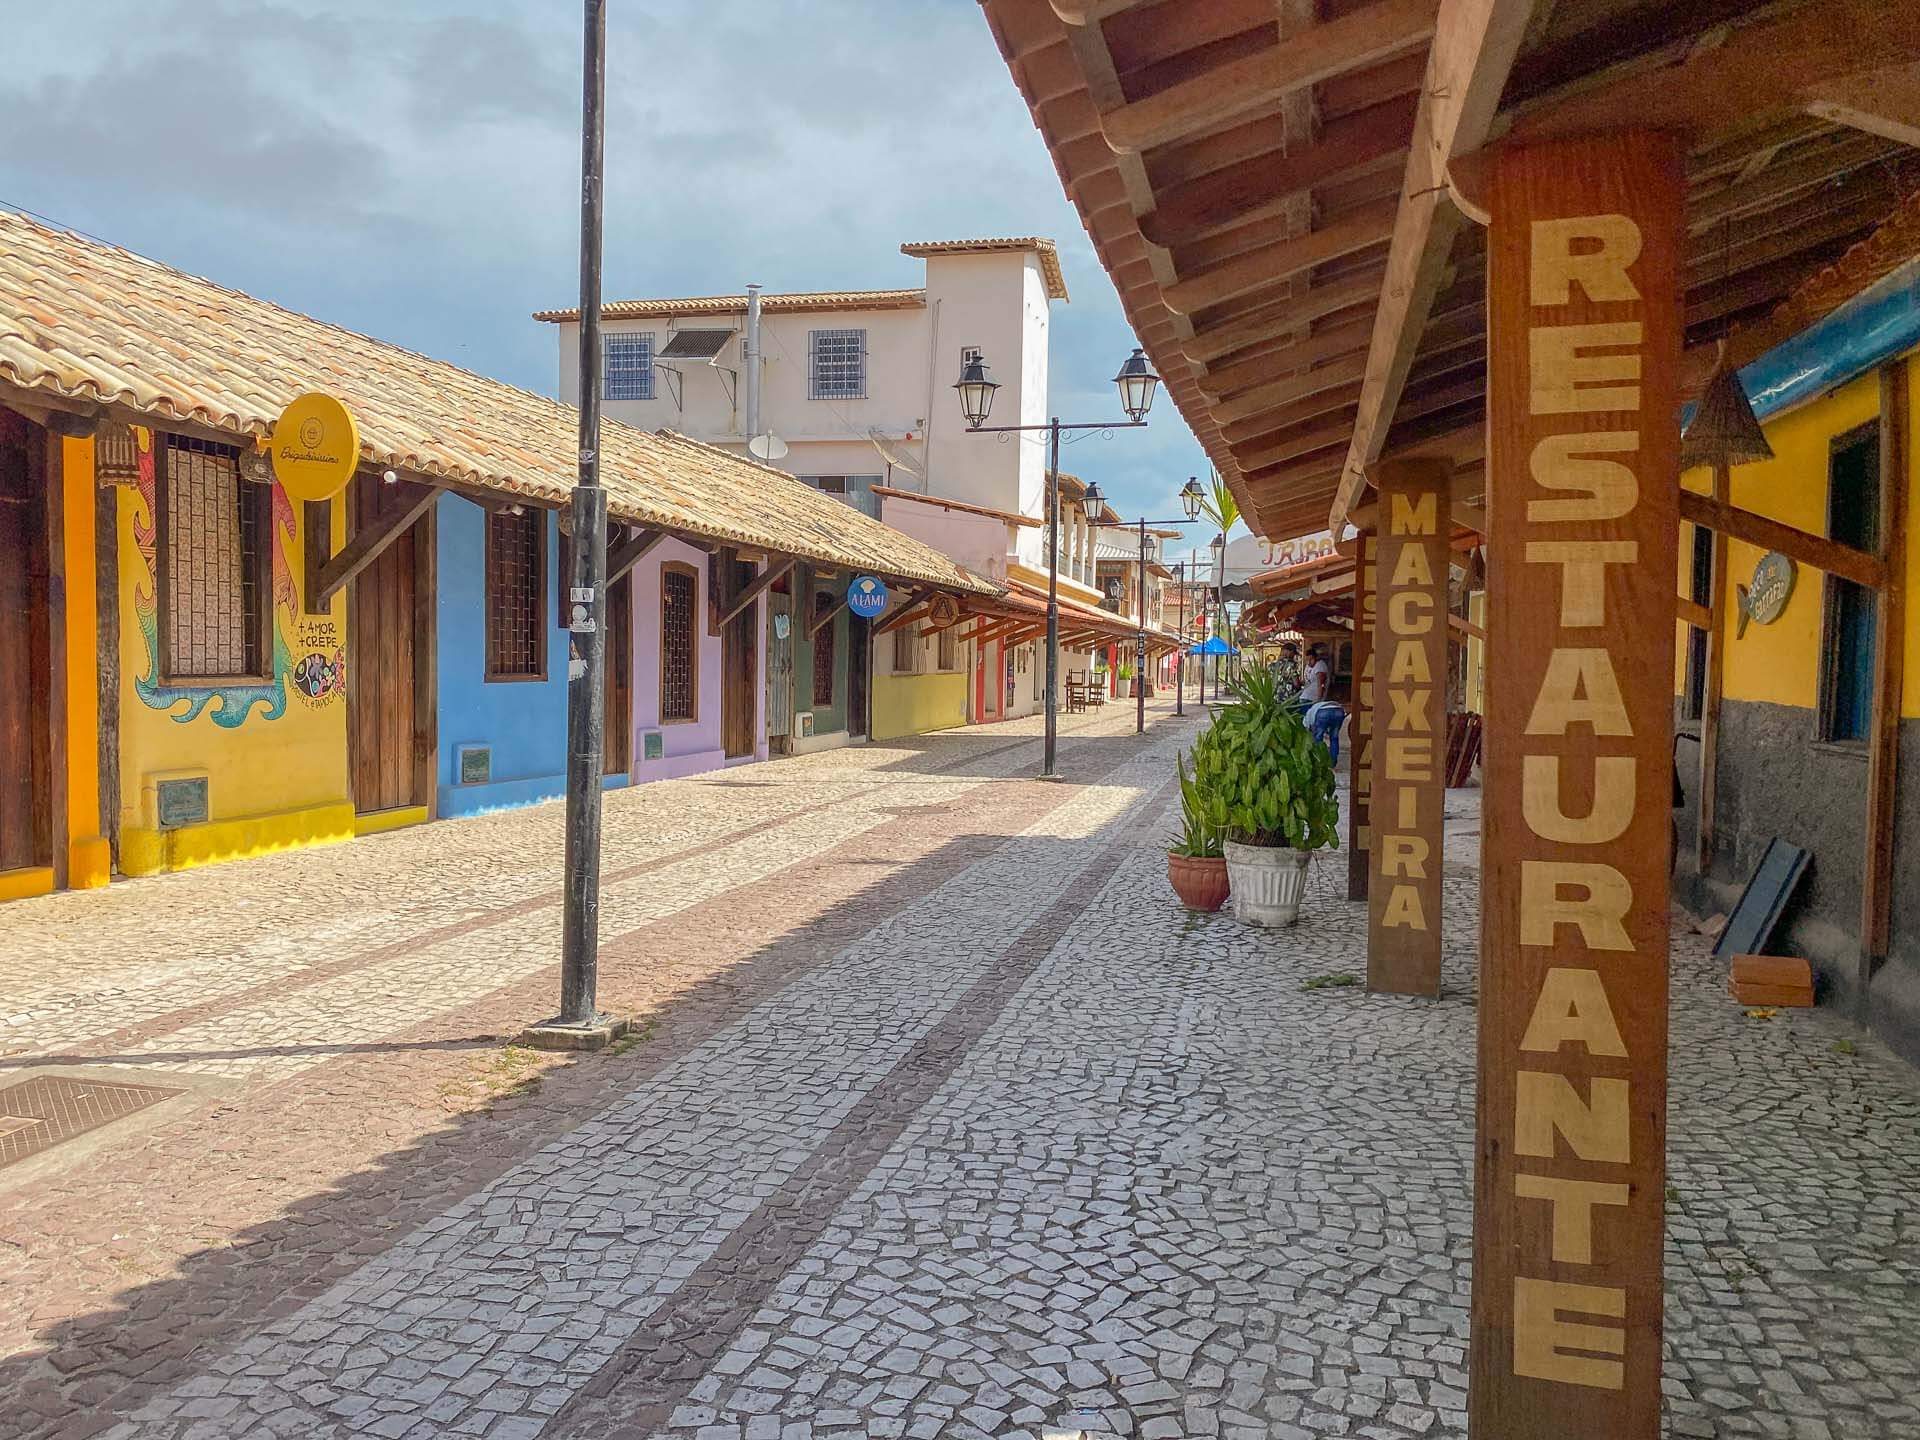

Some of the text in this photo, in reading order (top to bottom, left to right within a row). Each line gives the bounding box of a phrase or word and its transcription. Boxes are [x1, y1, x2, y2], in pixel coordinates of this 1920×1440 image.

[307, 621, 337, 635] AMOR
[1381, 492, 1437, 930] MACAXEIRA
[1513, 213, 1645, 1390] RESTAURANTE
